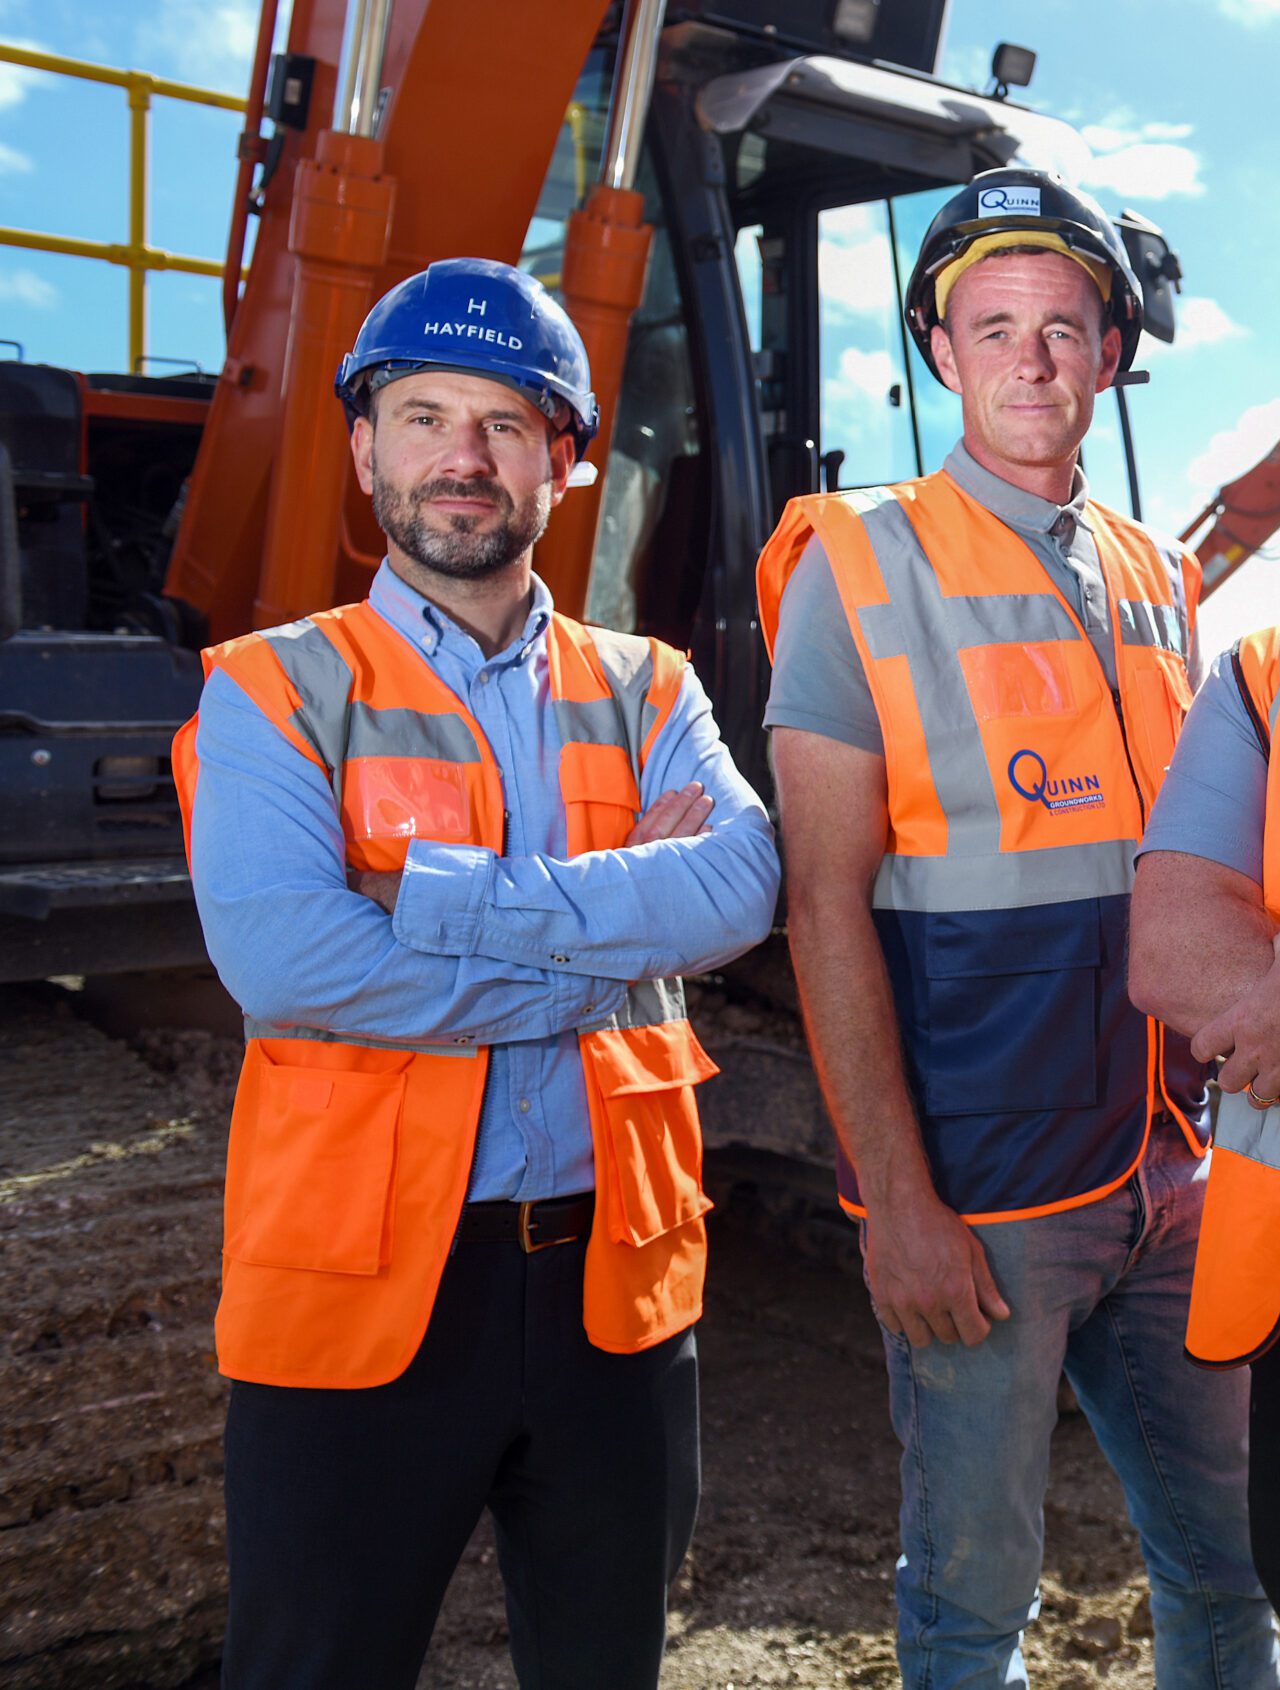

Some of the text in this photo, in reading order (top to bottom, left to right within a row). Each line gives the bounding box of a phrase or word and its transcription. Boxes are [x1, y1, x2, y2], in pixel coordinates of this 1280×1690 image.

[981, 189, 1039, 210] QUINN
[467, 298, 487, 316] H
[424, 322, 523, 350] HAYFIELD
[1008, 749, 1100, 809] QUINN
[1050, 794, 1103, 809] GROUNDWORKS
